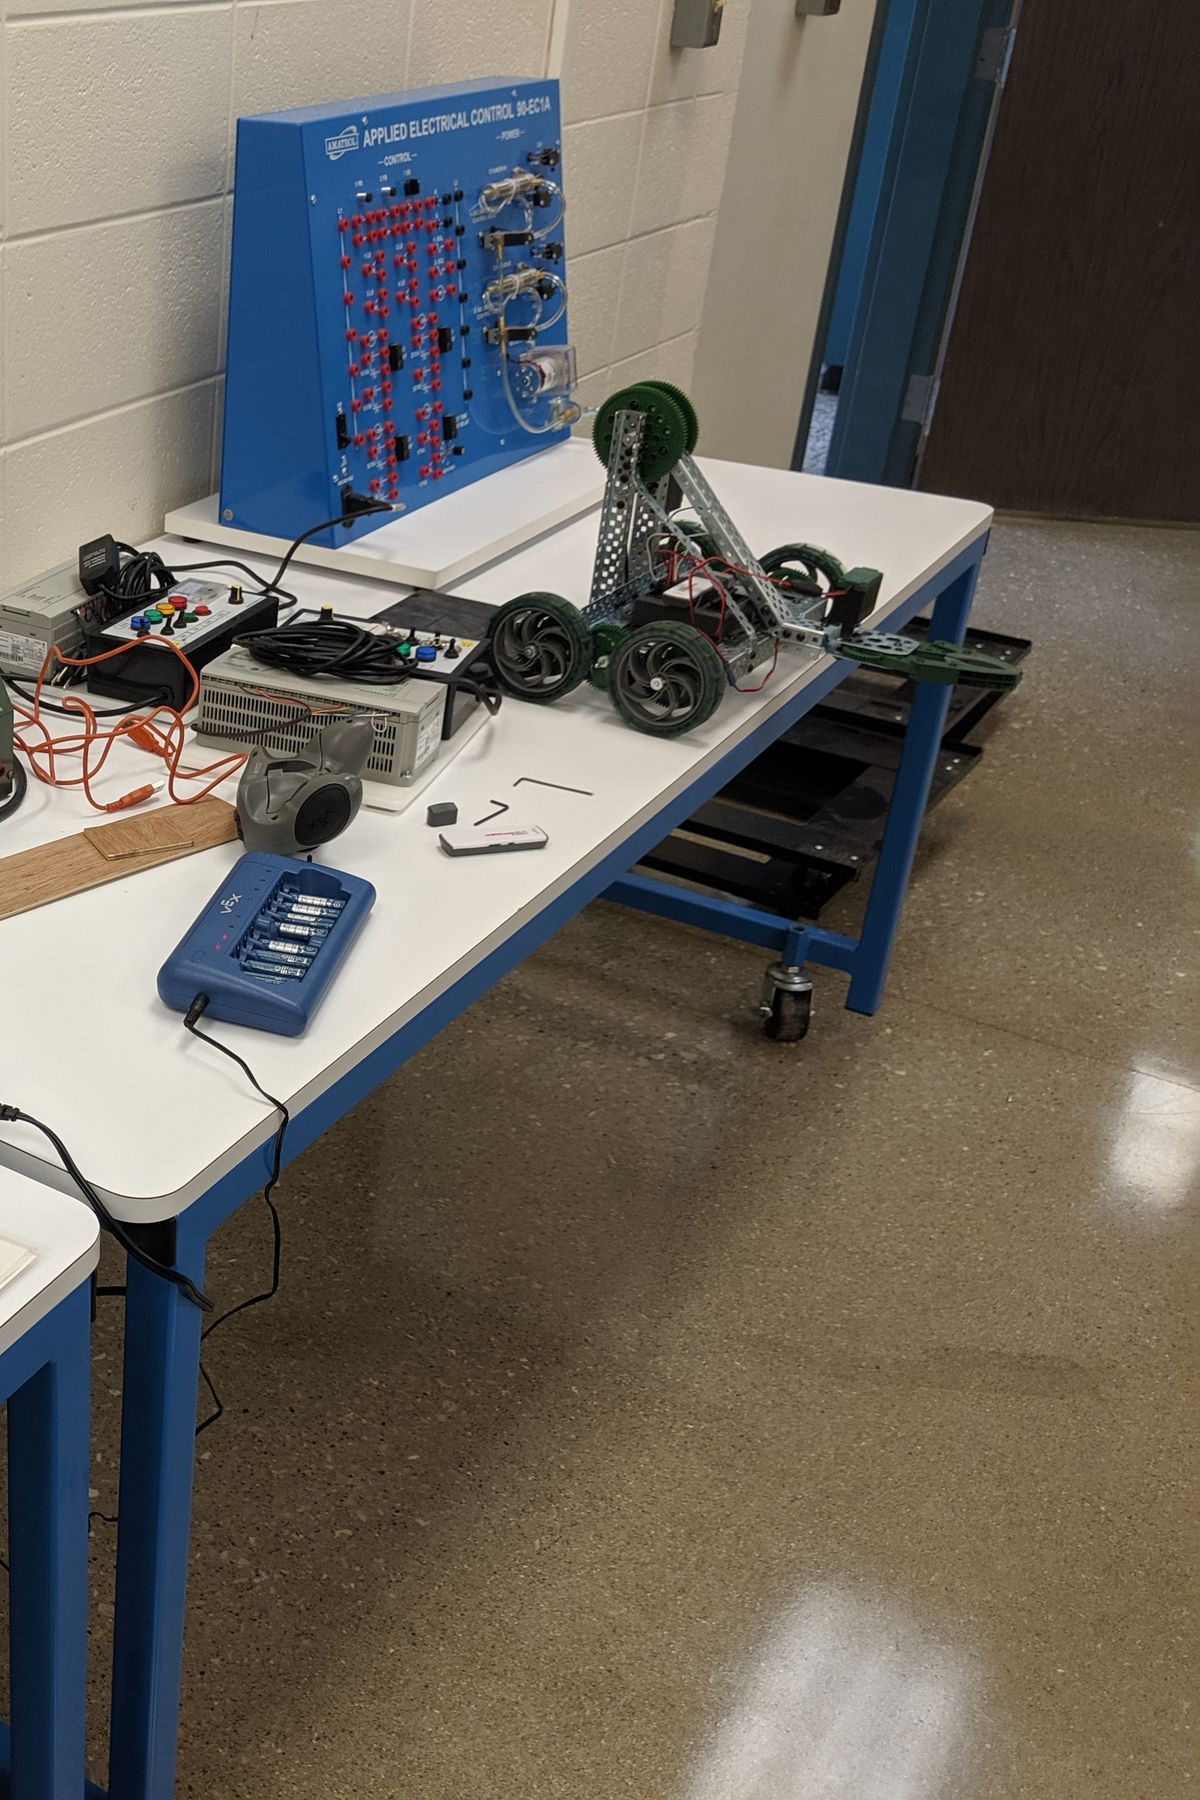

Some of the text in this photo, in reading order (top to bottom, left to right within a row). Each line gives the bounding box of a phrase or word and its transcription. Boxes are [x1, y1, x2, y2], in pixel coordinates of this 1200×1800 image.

[363, 96, 552, 148] APPLIED ELECTRICAL CONTROL 90-EC1A
[327, 136, 358, 153] AMATROL
[384, 153, 412, 167] CONTROL
[220, 893, 242, 915] VEX
